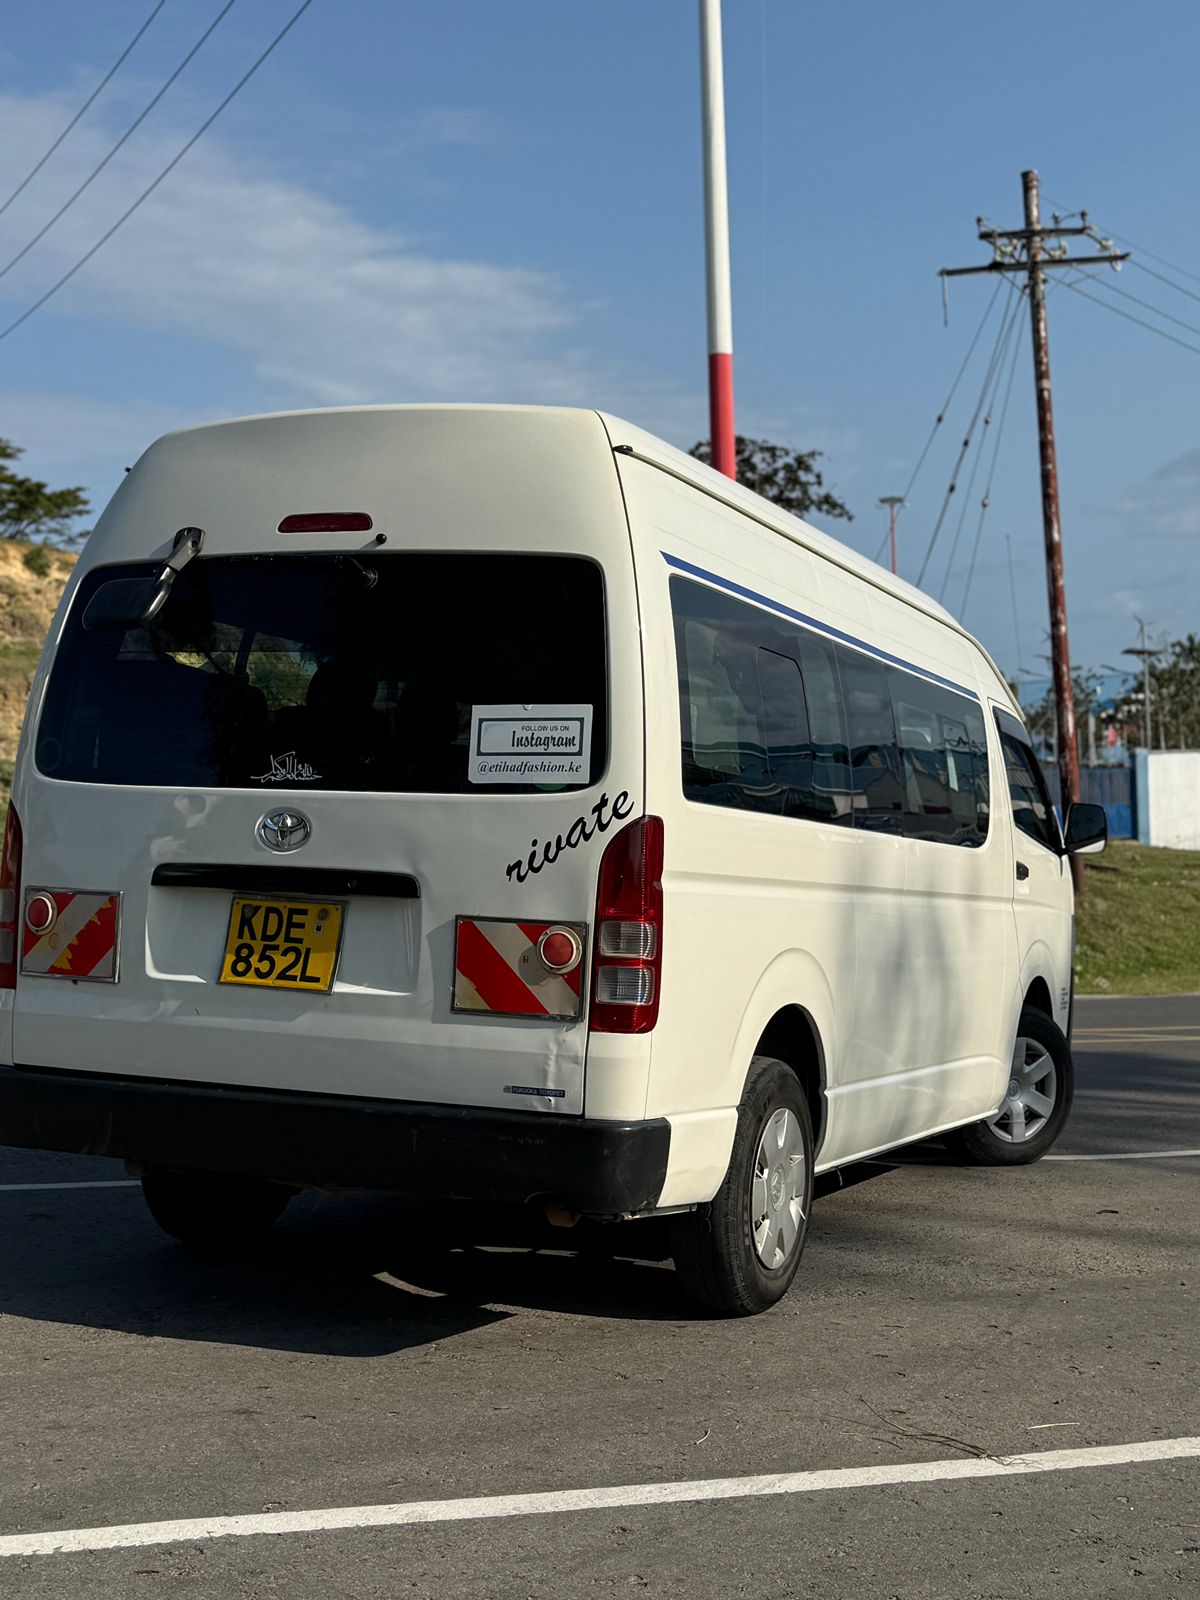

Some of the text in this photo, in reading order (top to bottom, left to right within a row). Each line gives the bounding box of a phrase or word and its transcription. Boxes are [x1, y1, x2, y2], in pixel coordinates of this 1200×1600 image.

[511, 730, 577, 751] Instagram
[478, 761, 582, 775] @etihadfashion.ke
[237, 904, 309, 944] KDE
[230, 942, 321, 983] 852L
